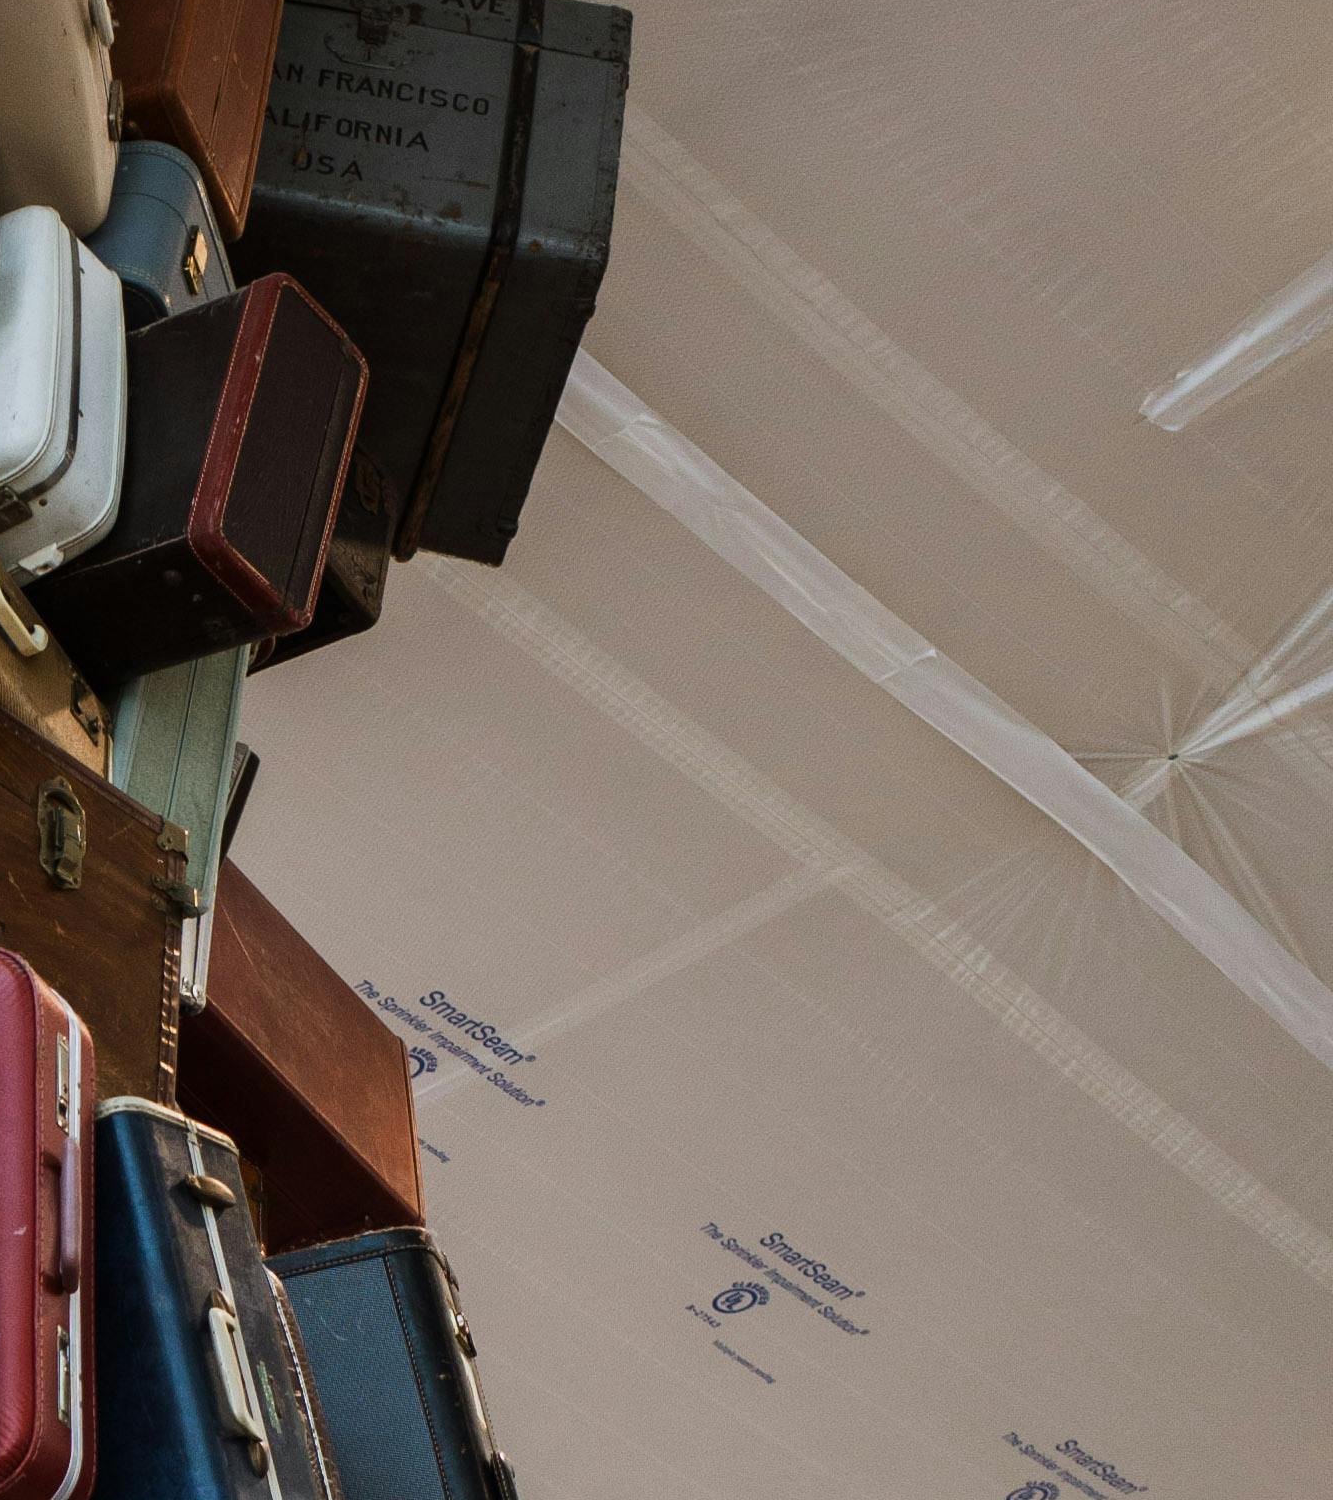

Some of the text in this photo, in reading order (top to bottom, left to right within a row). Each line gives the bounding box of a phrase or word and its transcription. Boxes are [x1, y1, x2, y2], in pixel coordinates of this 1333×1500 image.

[271, 63, 490, 117] AN FRANCISCO
[263, 104, 431, 152] ALIFORNIA
[354, 979, 381, 1000] The
